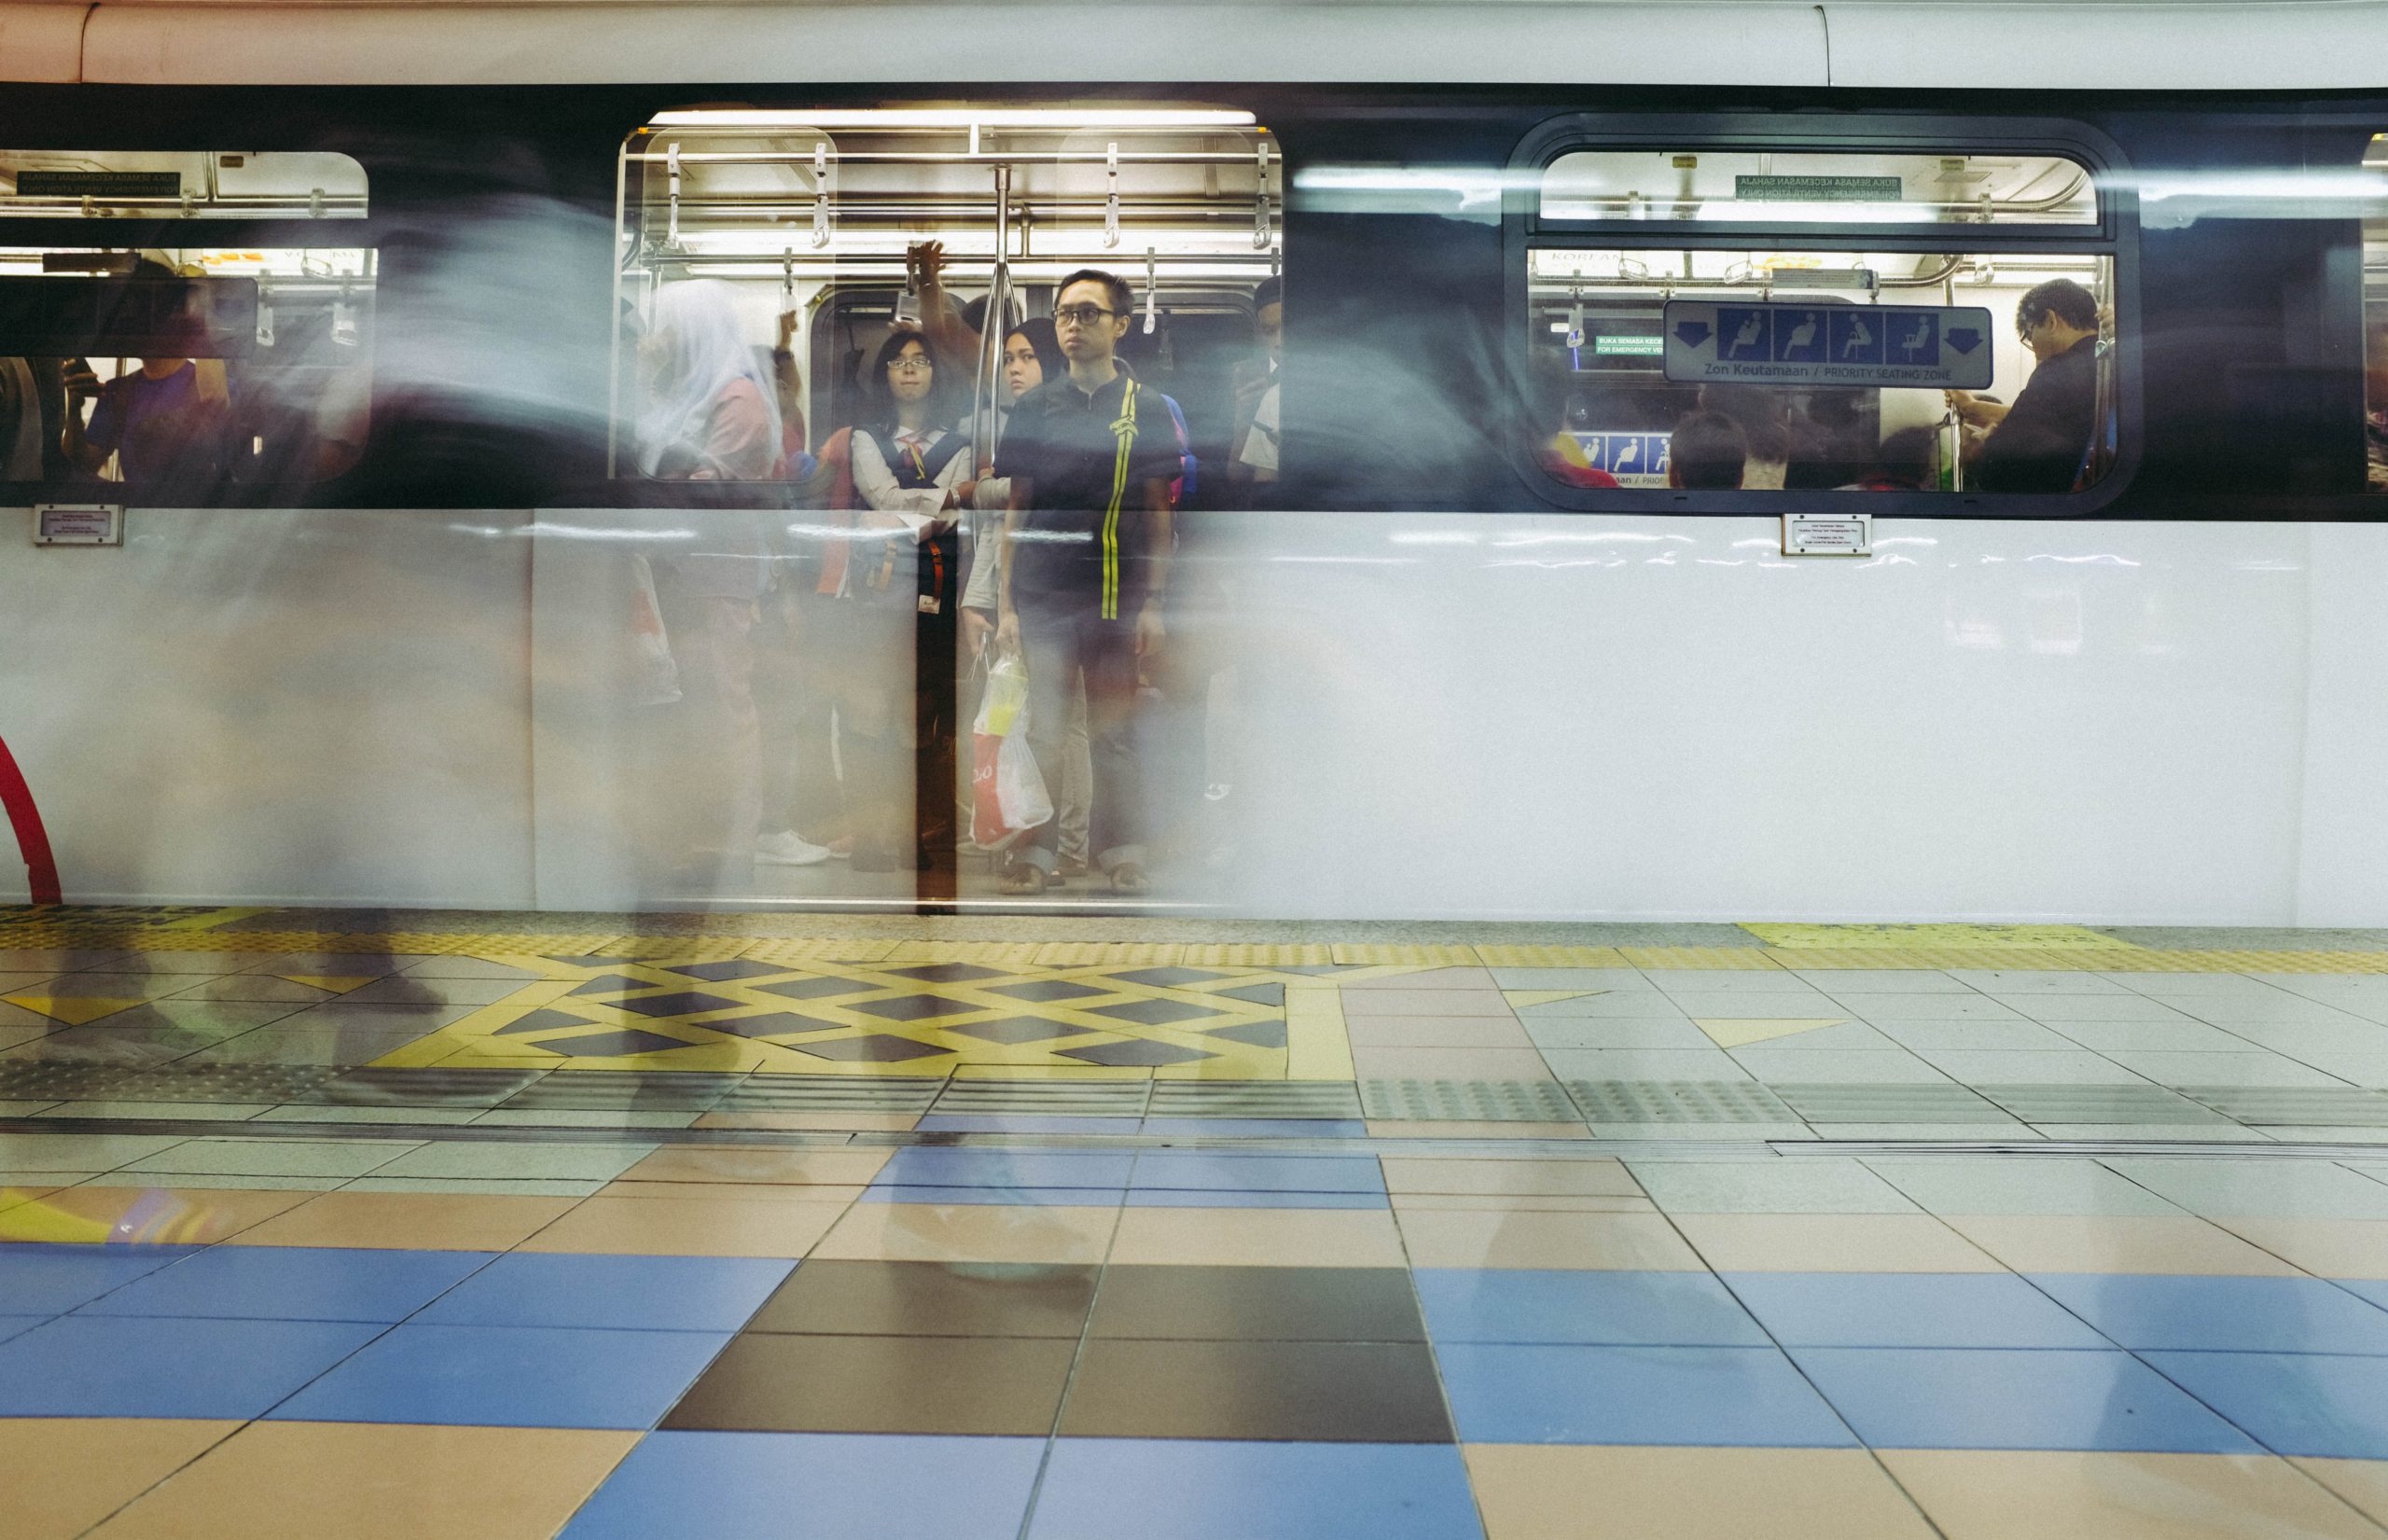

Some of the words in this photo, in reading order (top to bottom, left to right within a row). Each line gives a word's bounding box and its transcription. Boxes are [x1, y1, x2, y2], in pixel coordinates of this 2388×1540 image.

[1704, 363, 1729, 375] Zon
[1733, 363, 1809, 377] Keutamaan
[1824, 367, 1873, 379] PRIORITY
[1876, 368, 1920, 381] SEATING
[1923, 369, 1952, 382] ZONE
